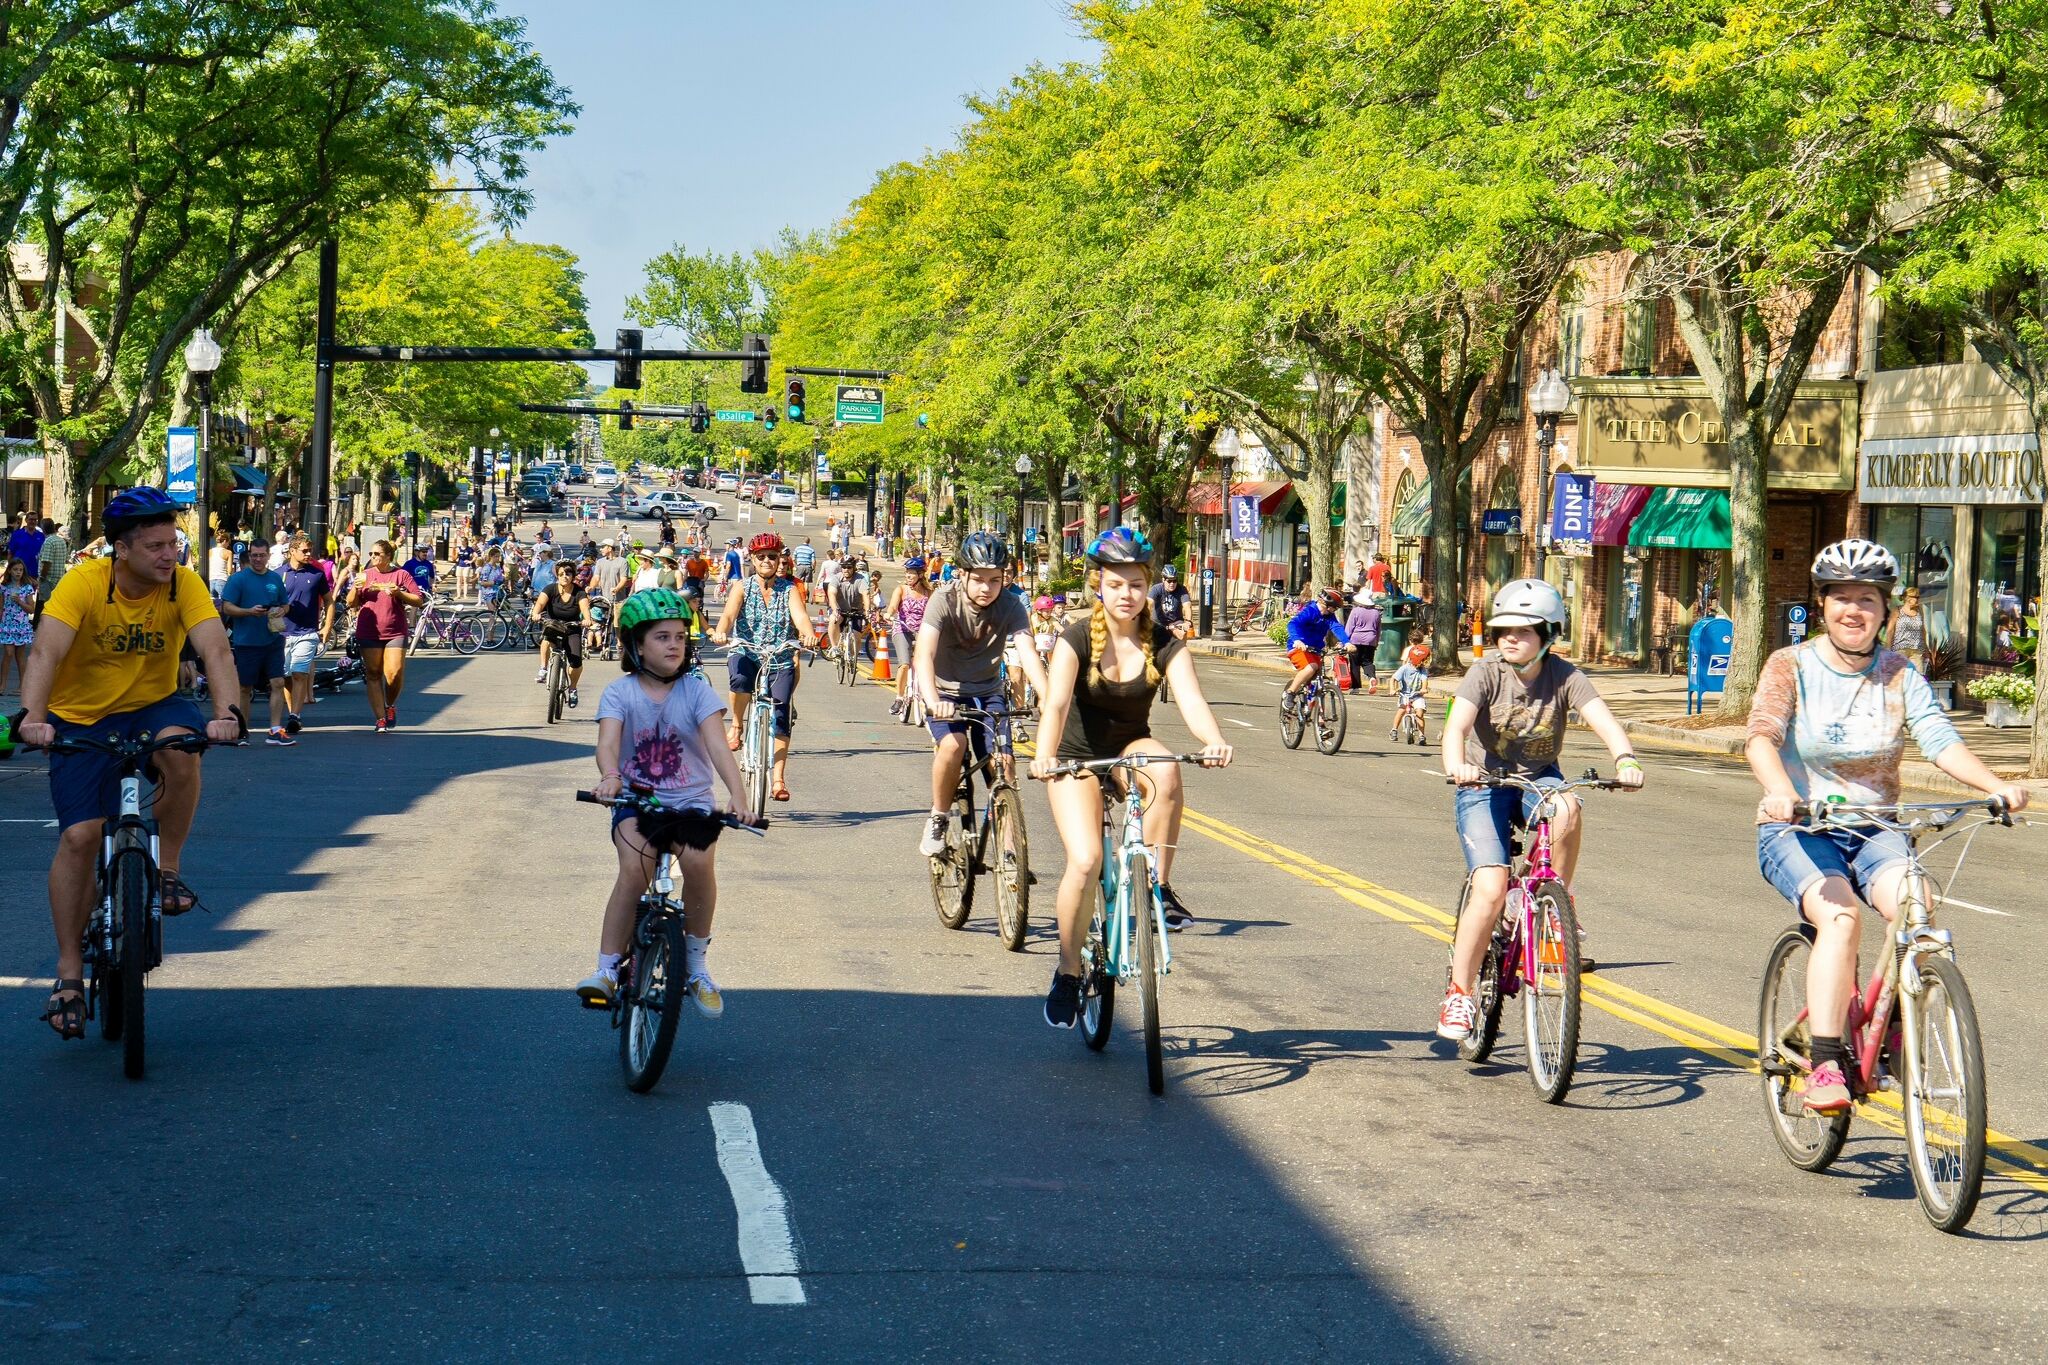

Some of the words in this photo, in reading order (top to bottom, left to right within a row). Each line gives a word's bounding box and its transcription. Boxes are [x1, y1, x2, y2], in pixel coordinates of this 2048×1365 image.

[717, 411, 746, 421] LaSalle
[1606, 419, 1667, 443] THE
[1866, 452, 1954, 489] KIMBERLY
[1239, 502, 1251, 533] SHOP
[1564, 484, 1583, 531] DINE
[1485, 520, 1507, 530] LIBERTY
